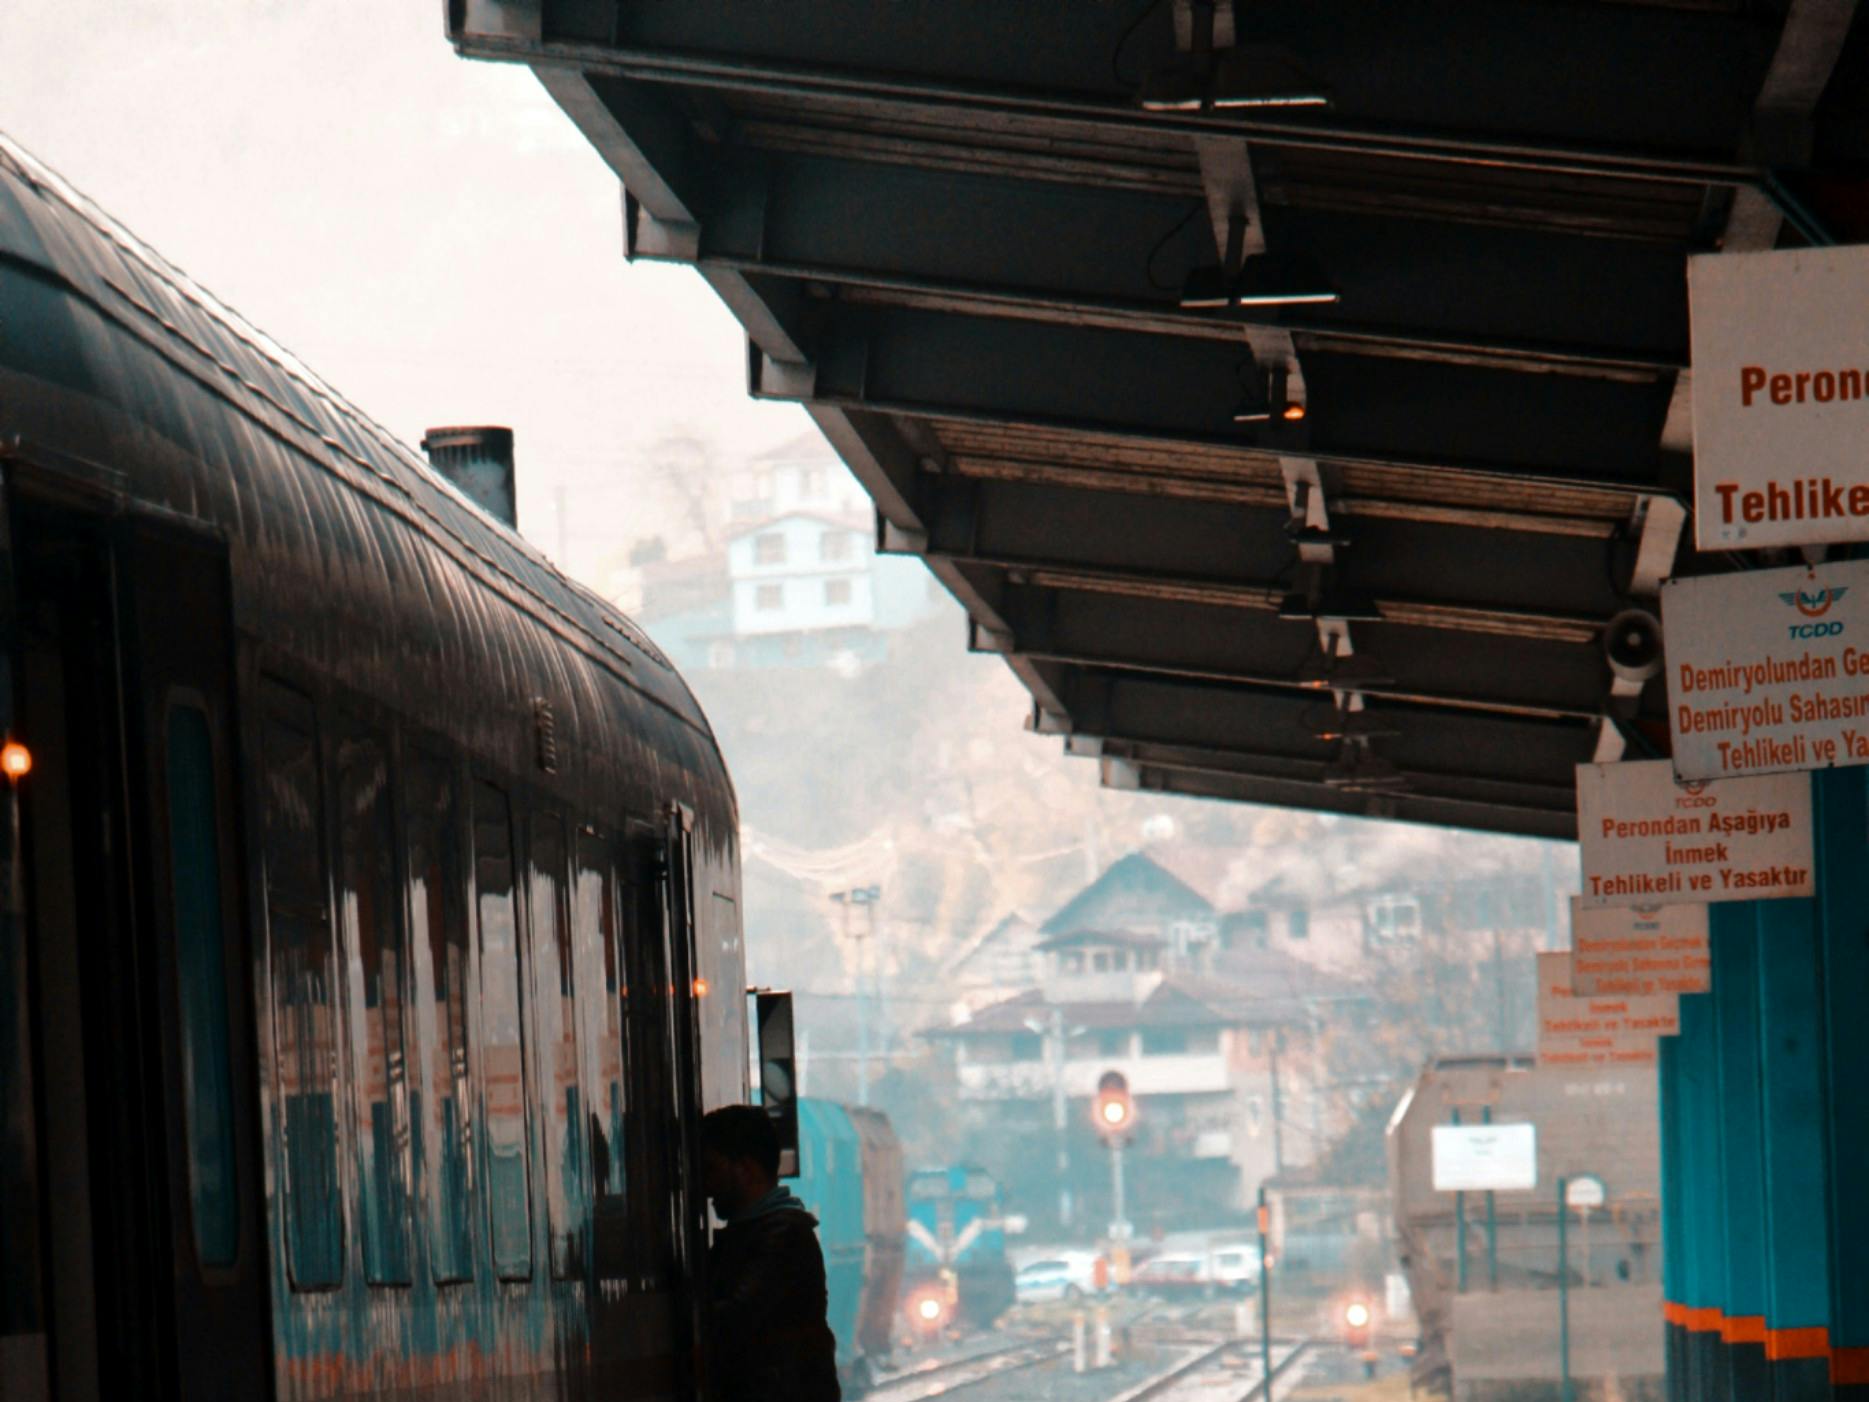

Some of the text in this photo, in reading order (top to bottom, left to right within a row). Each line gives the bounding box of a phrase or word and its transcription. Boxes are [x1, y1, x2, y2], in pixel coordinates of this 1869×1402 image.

[1741, 366, 1869, 407] Peron
[1788, 621, 1844, 640] TCDD
[1679, 646, 1869, 694] Demiryolundan Ge
[1678, 697, 1783, 736] Demiryolu
[1717, 729, 1869, 771] Tehlikeli ve Ya
[1602, 810, 1792, 838] Perondan Aşağıya
[1665, 841, 1729, 865] İnmek
[1588, 866, 1808, 896] Tehlikeli ve Yasaktır
